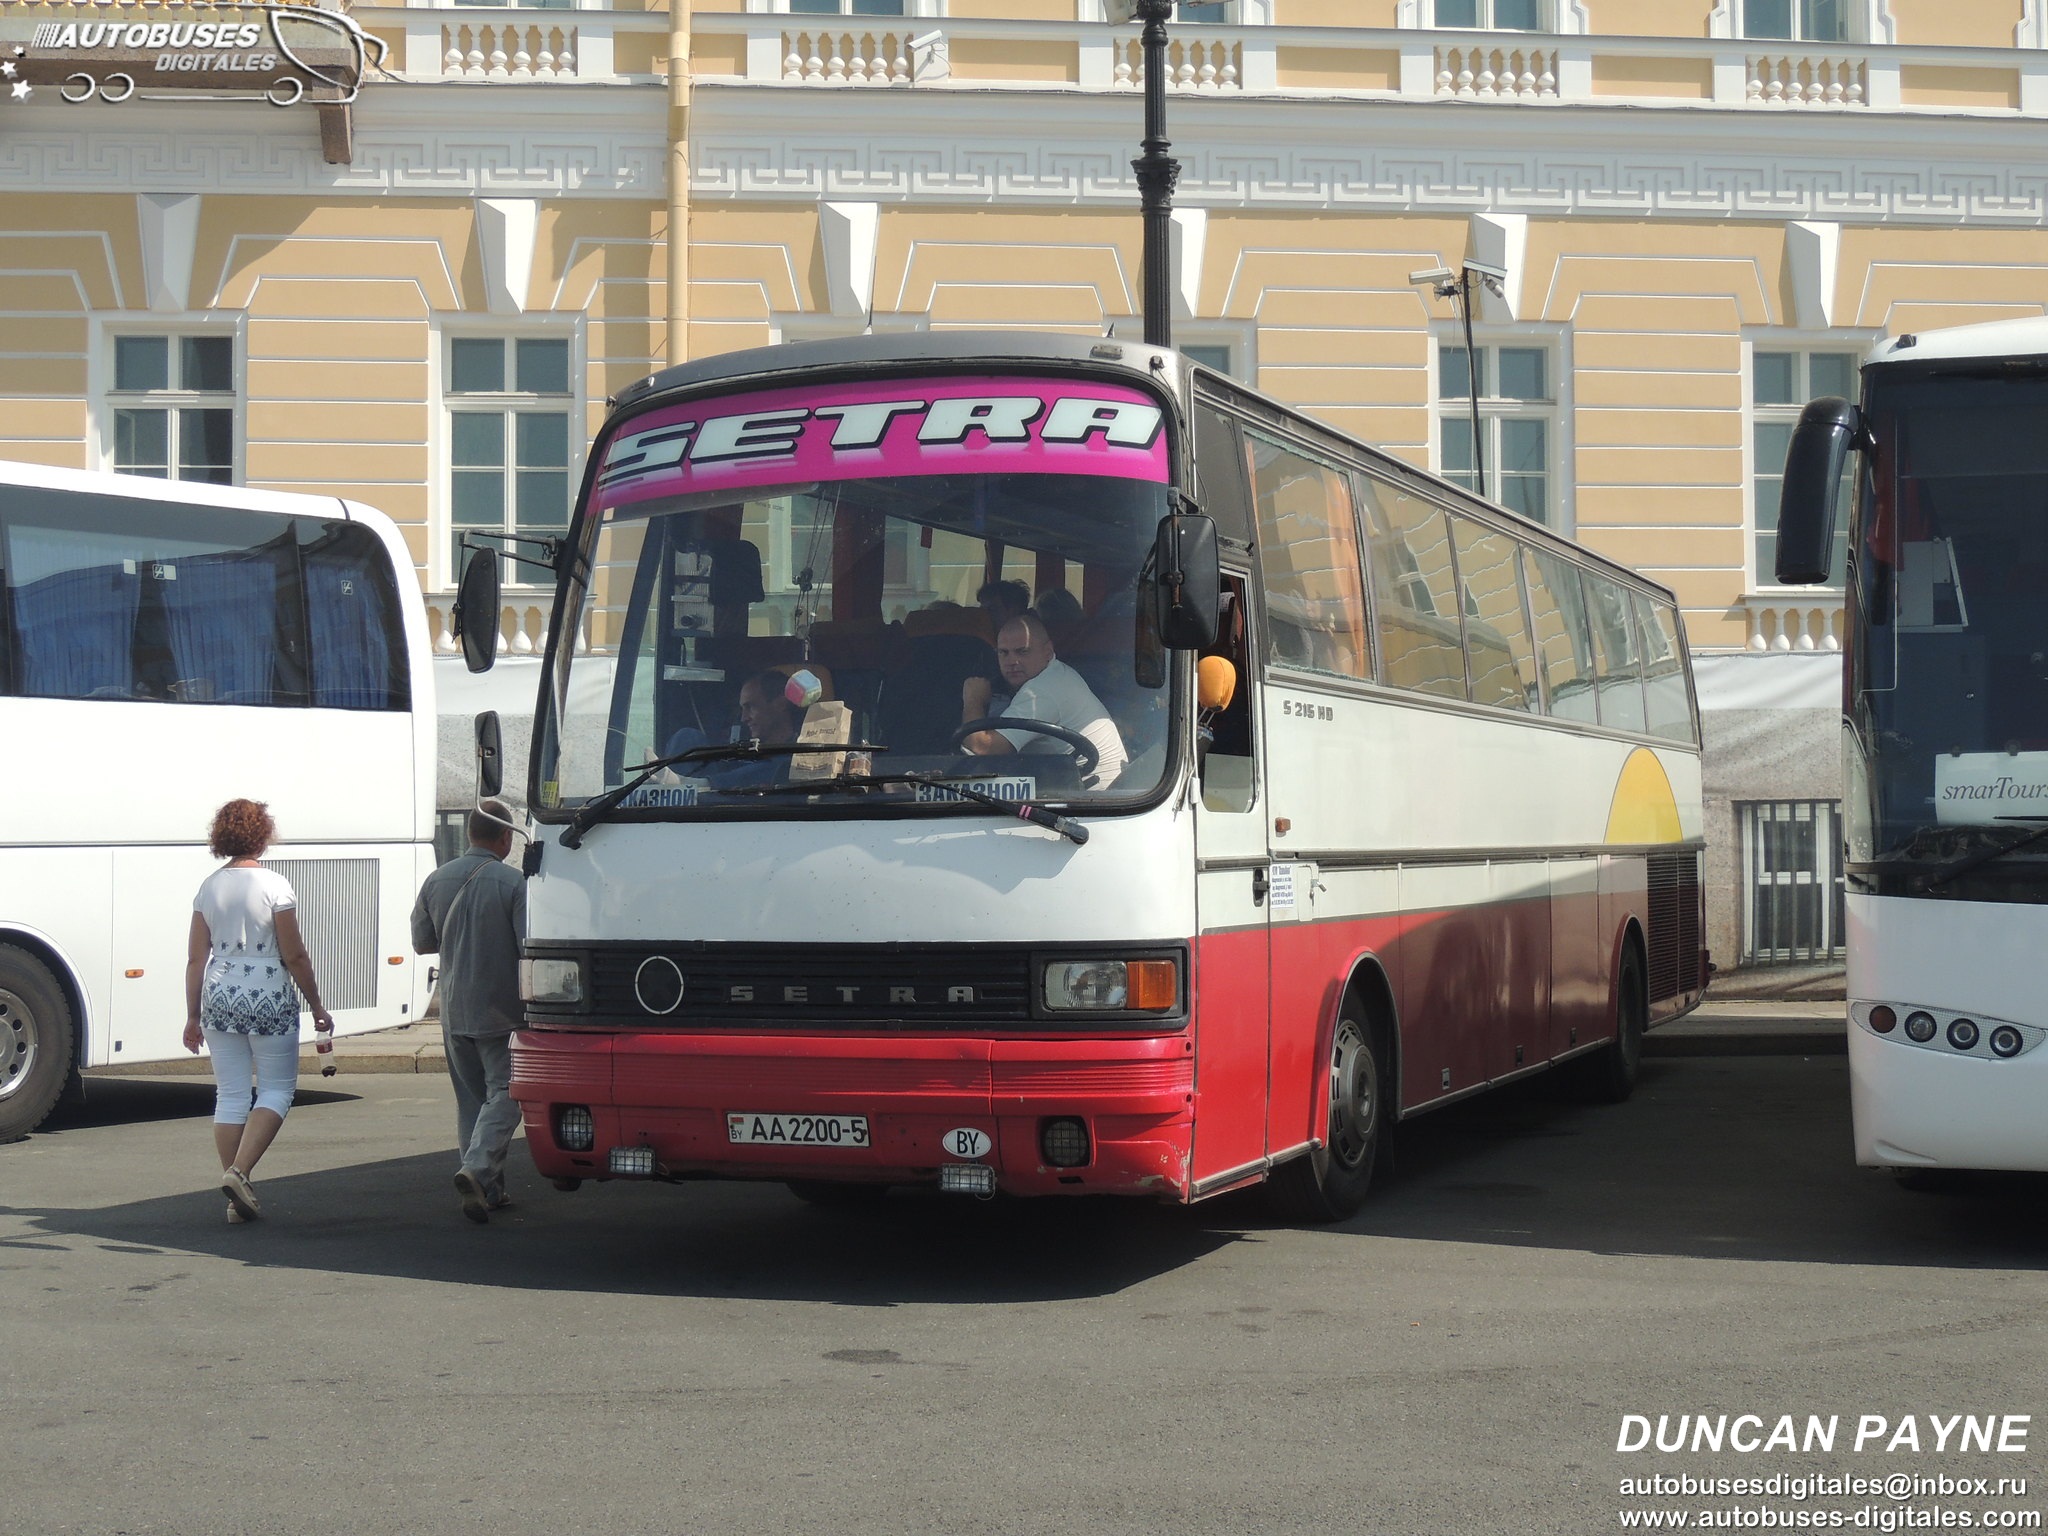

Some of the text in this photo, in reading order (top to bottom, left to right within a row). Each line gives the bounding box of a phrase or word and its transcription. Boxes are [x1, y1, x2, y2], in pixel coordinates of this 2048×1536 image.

[599, 396, 1165, 482] SETRA
[1283, 699, 1292, 715] S
[1295, 701, 1315, 719] 215
[617, 784, 697, 807] КАЗНОЙ
[730, 985, 974, 1002] SETRA
[731, 1115, 867, 1144] BY AA2200-5
[956, 1130, 980, 1155] BY
